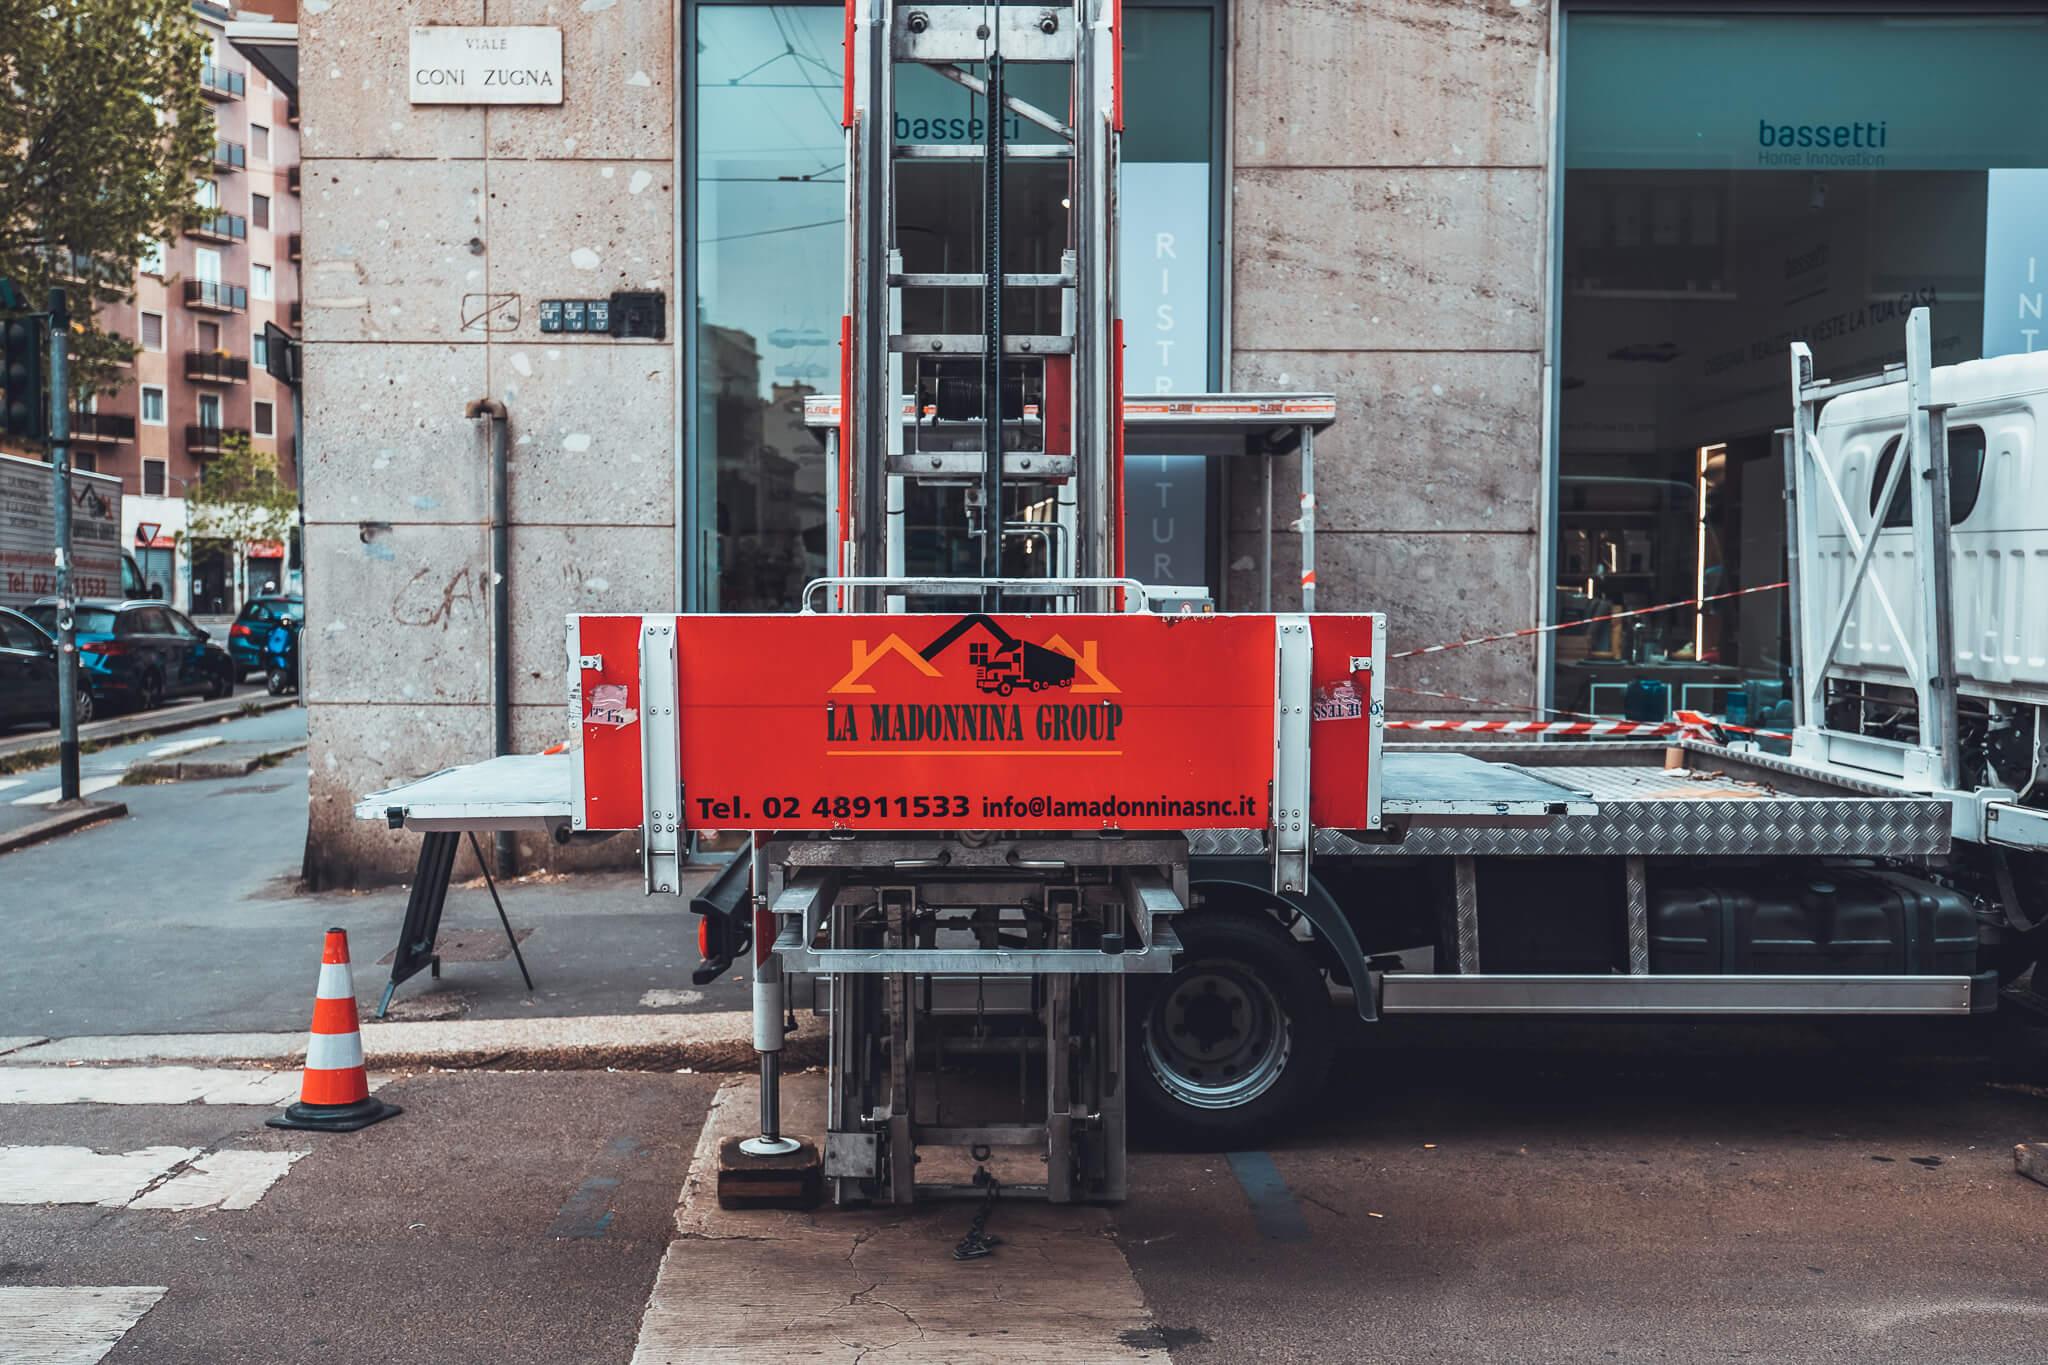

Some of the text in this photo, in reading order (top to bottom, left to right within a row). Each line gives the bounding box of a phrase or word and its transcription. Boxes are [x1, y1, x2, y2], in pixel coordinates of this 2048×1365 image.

[465, 38, 508, 50] VIALE
[416, 69, 553, 86] CONI ZUGNA
[894, 111, 1019, 140] basseti
[1759, 119, 1887, 148] bassetti
[1758, 151, 1886, 166] Home Innovation
[1869, 302, 1896, 325] TUA
[32, 572, 49, 594] 02
[826, 703, 1123, 741] LA MADONNINA GROUP
[696, 795, 1256, 820] Tel. 02 48911533 info@lamadonninasnc.it
